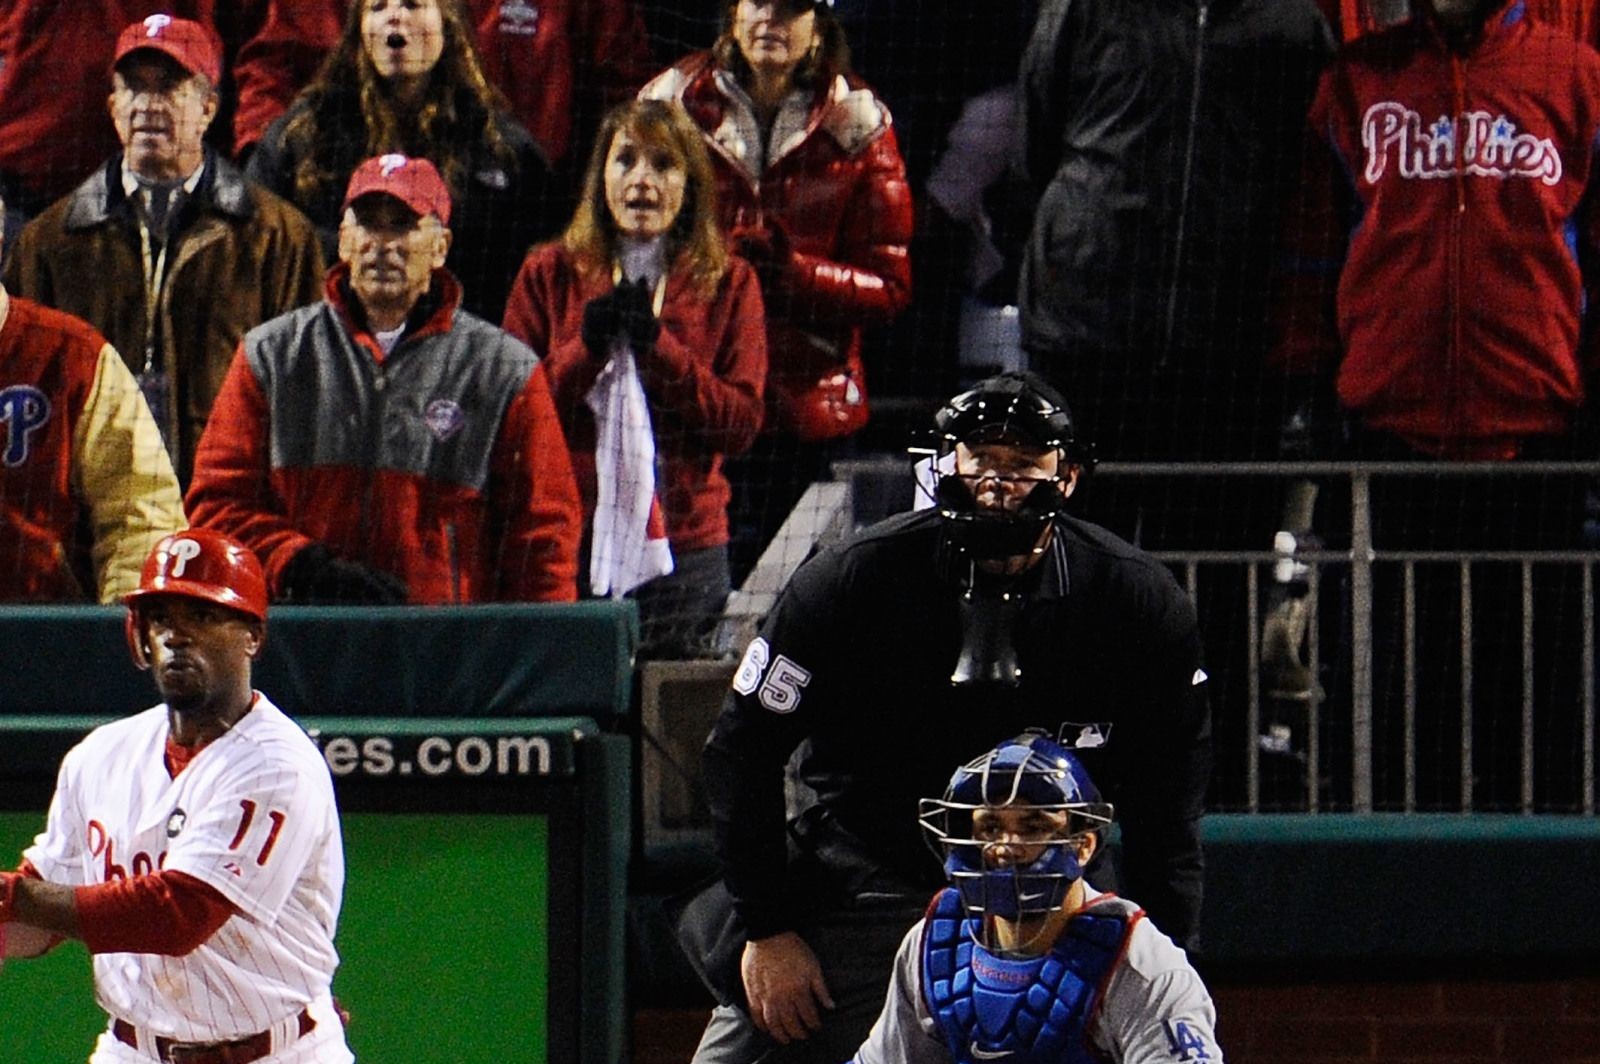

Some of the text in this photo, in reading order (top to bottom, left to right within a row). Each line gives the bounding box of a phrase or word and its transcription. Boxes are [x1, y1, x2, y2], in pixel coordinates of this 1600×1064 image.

[1362, 101, 1563, 186] Phillies
[169, 538, 201, 578] P
[733, 636, 812, 714] 65
[228, 798, 287, 867] 11
[1161, 1018, 1211, 1063] LA
